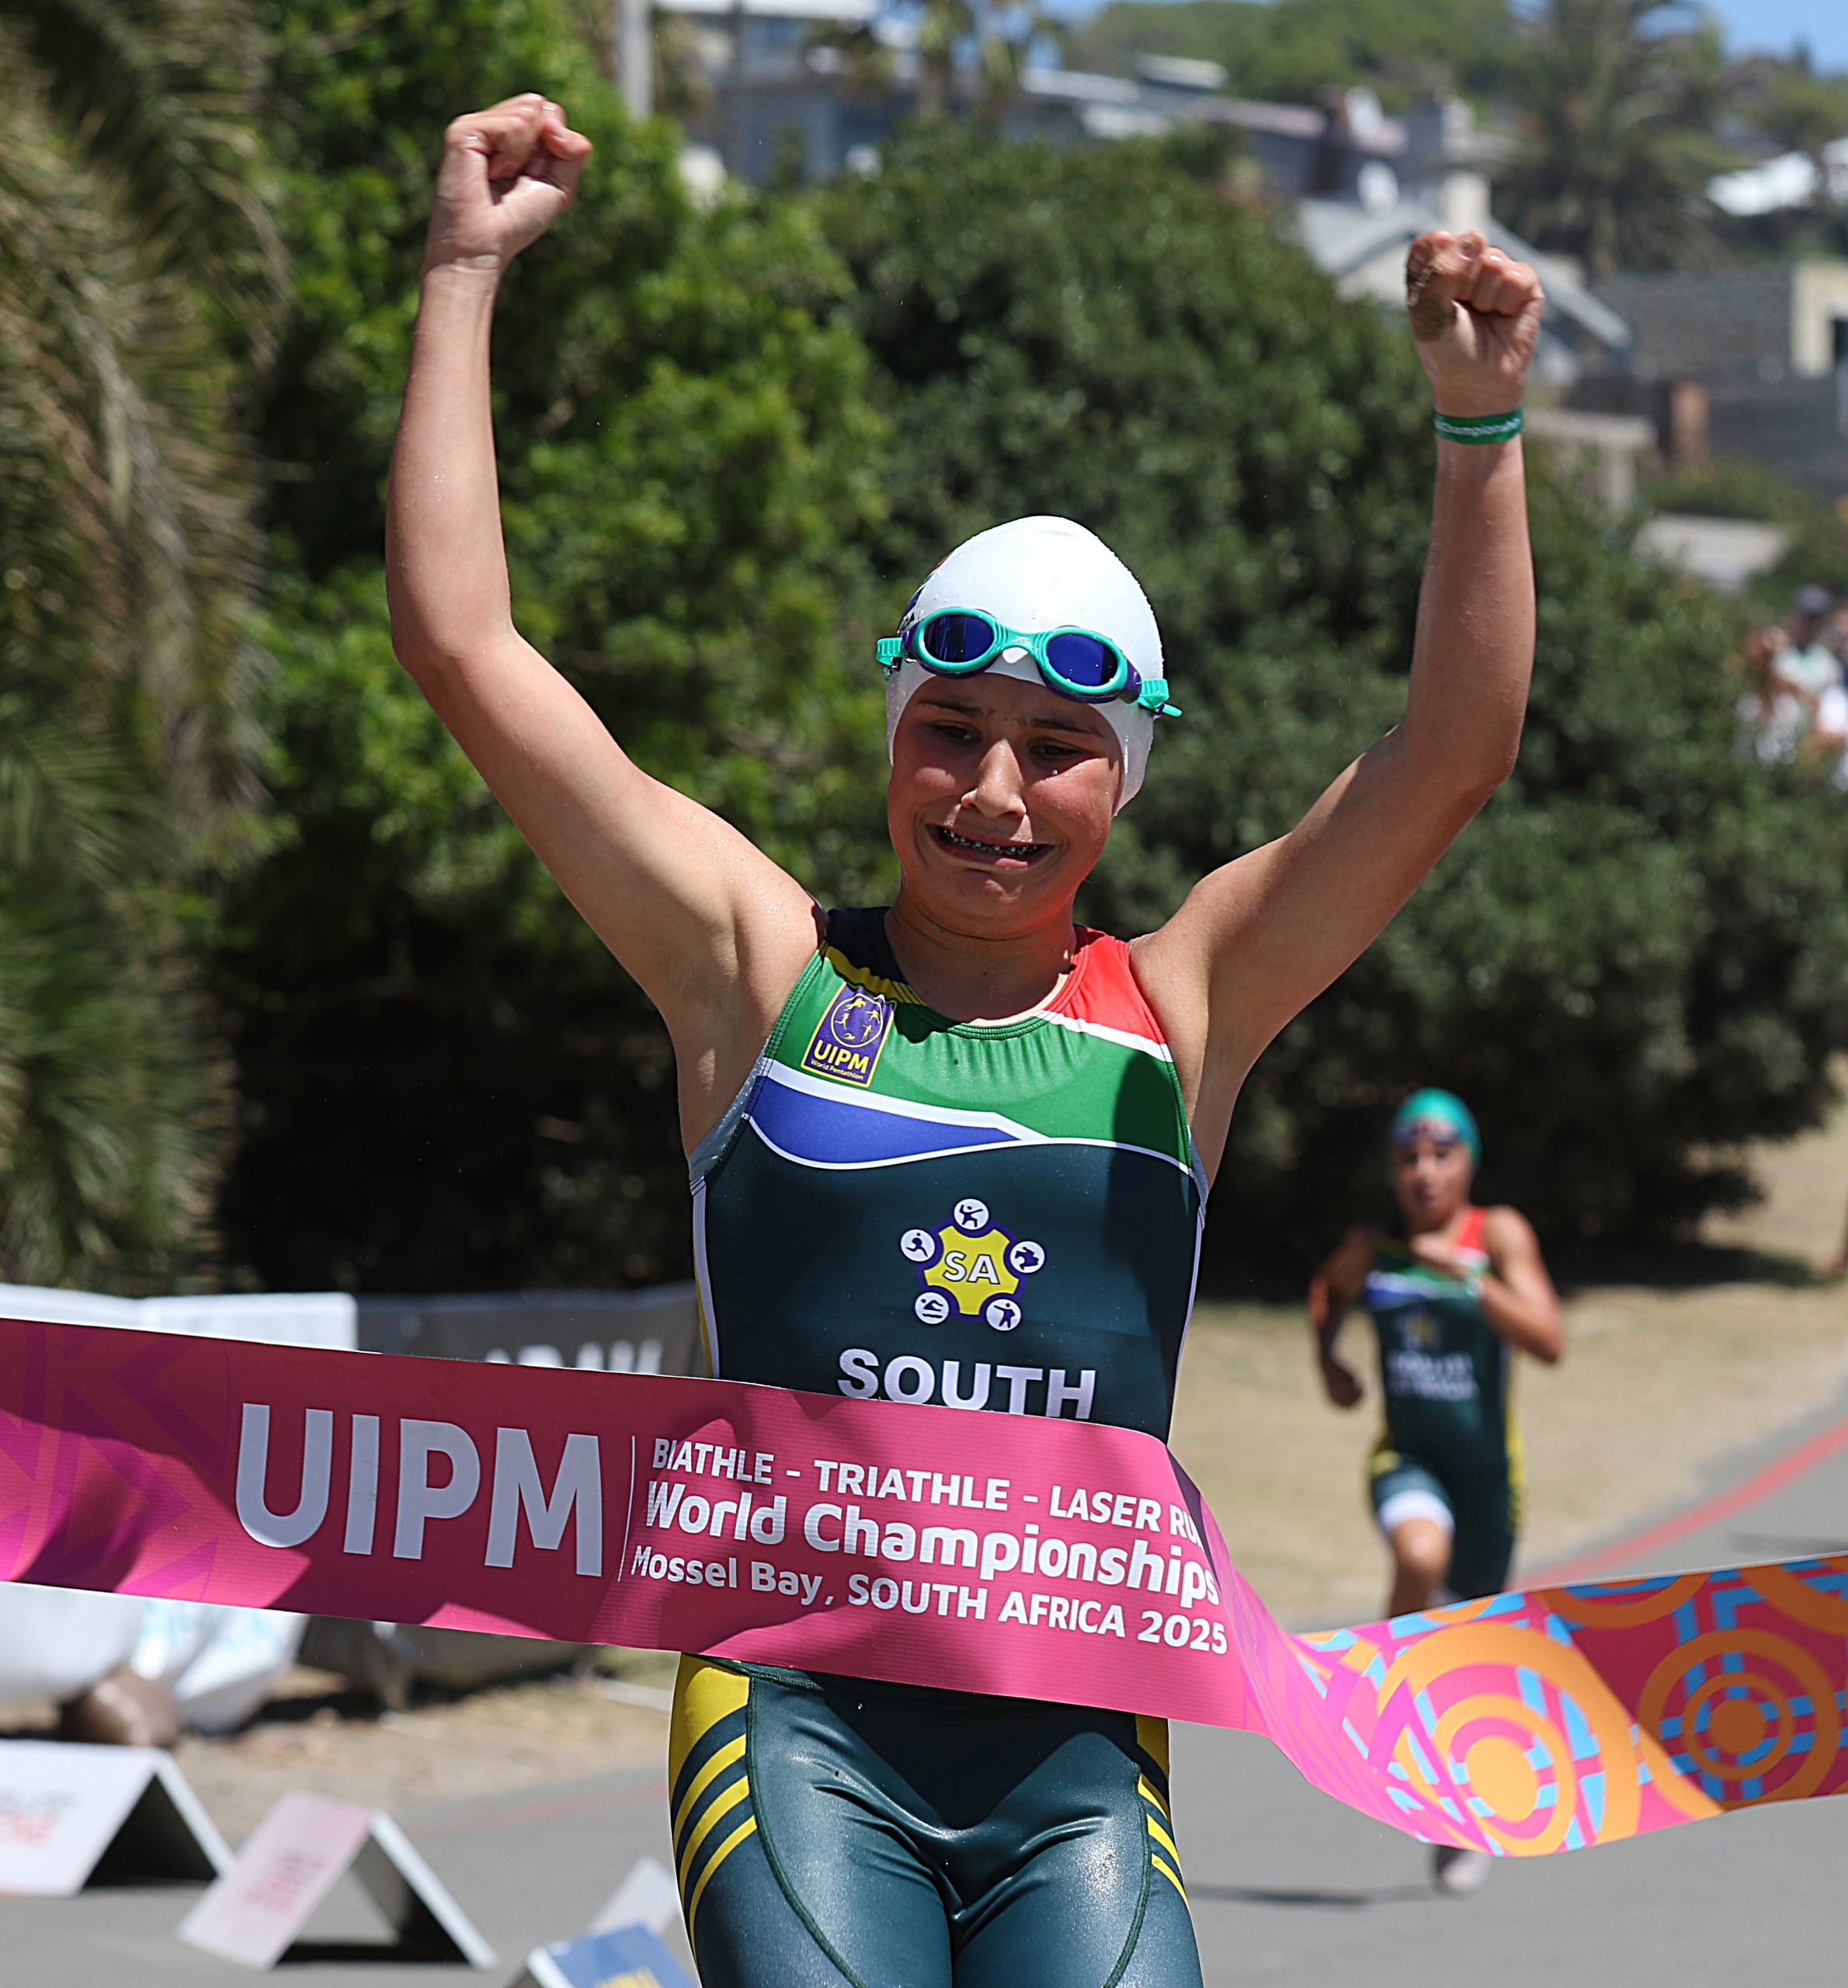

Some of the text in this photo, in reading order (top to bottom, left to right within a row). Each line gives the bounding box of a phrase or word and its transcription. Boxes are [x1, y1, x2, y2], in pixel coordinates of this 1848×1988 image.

[810, 1058, 864, 1080] World Pentathlon
[813, 1039, 870, 1074] UIPM
[942, 1250, 1001, 1285] SA
[837, 1348, 1096, 1420] SOUTH
[235, 1402, 603, 1577] UIPM
[652, 1437, 775, 1486] BIATHLE
[814, 1459, 1011, 1511] TRIATHLE
[1049, 1484, 1162, 1533] LASER
[646, 1480, 1221, 1609] World Championships
[631, 1545, 1228, 1656] Mossel Bay, SOUTH AFRICA 2025
